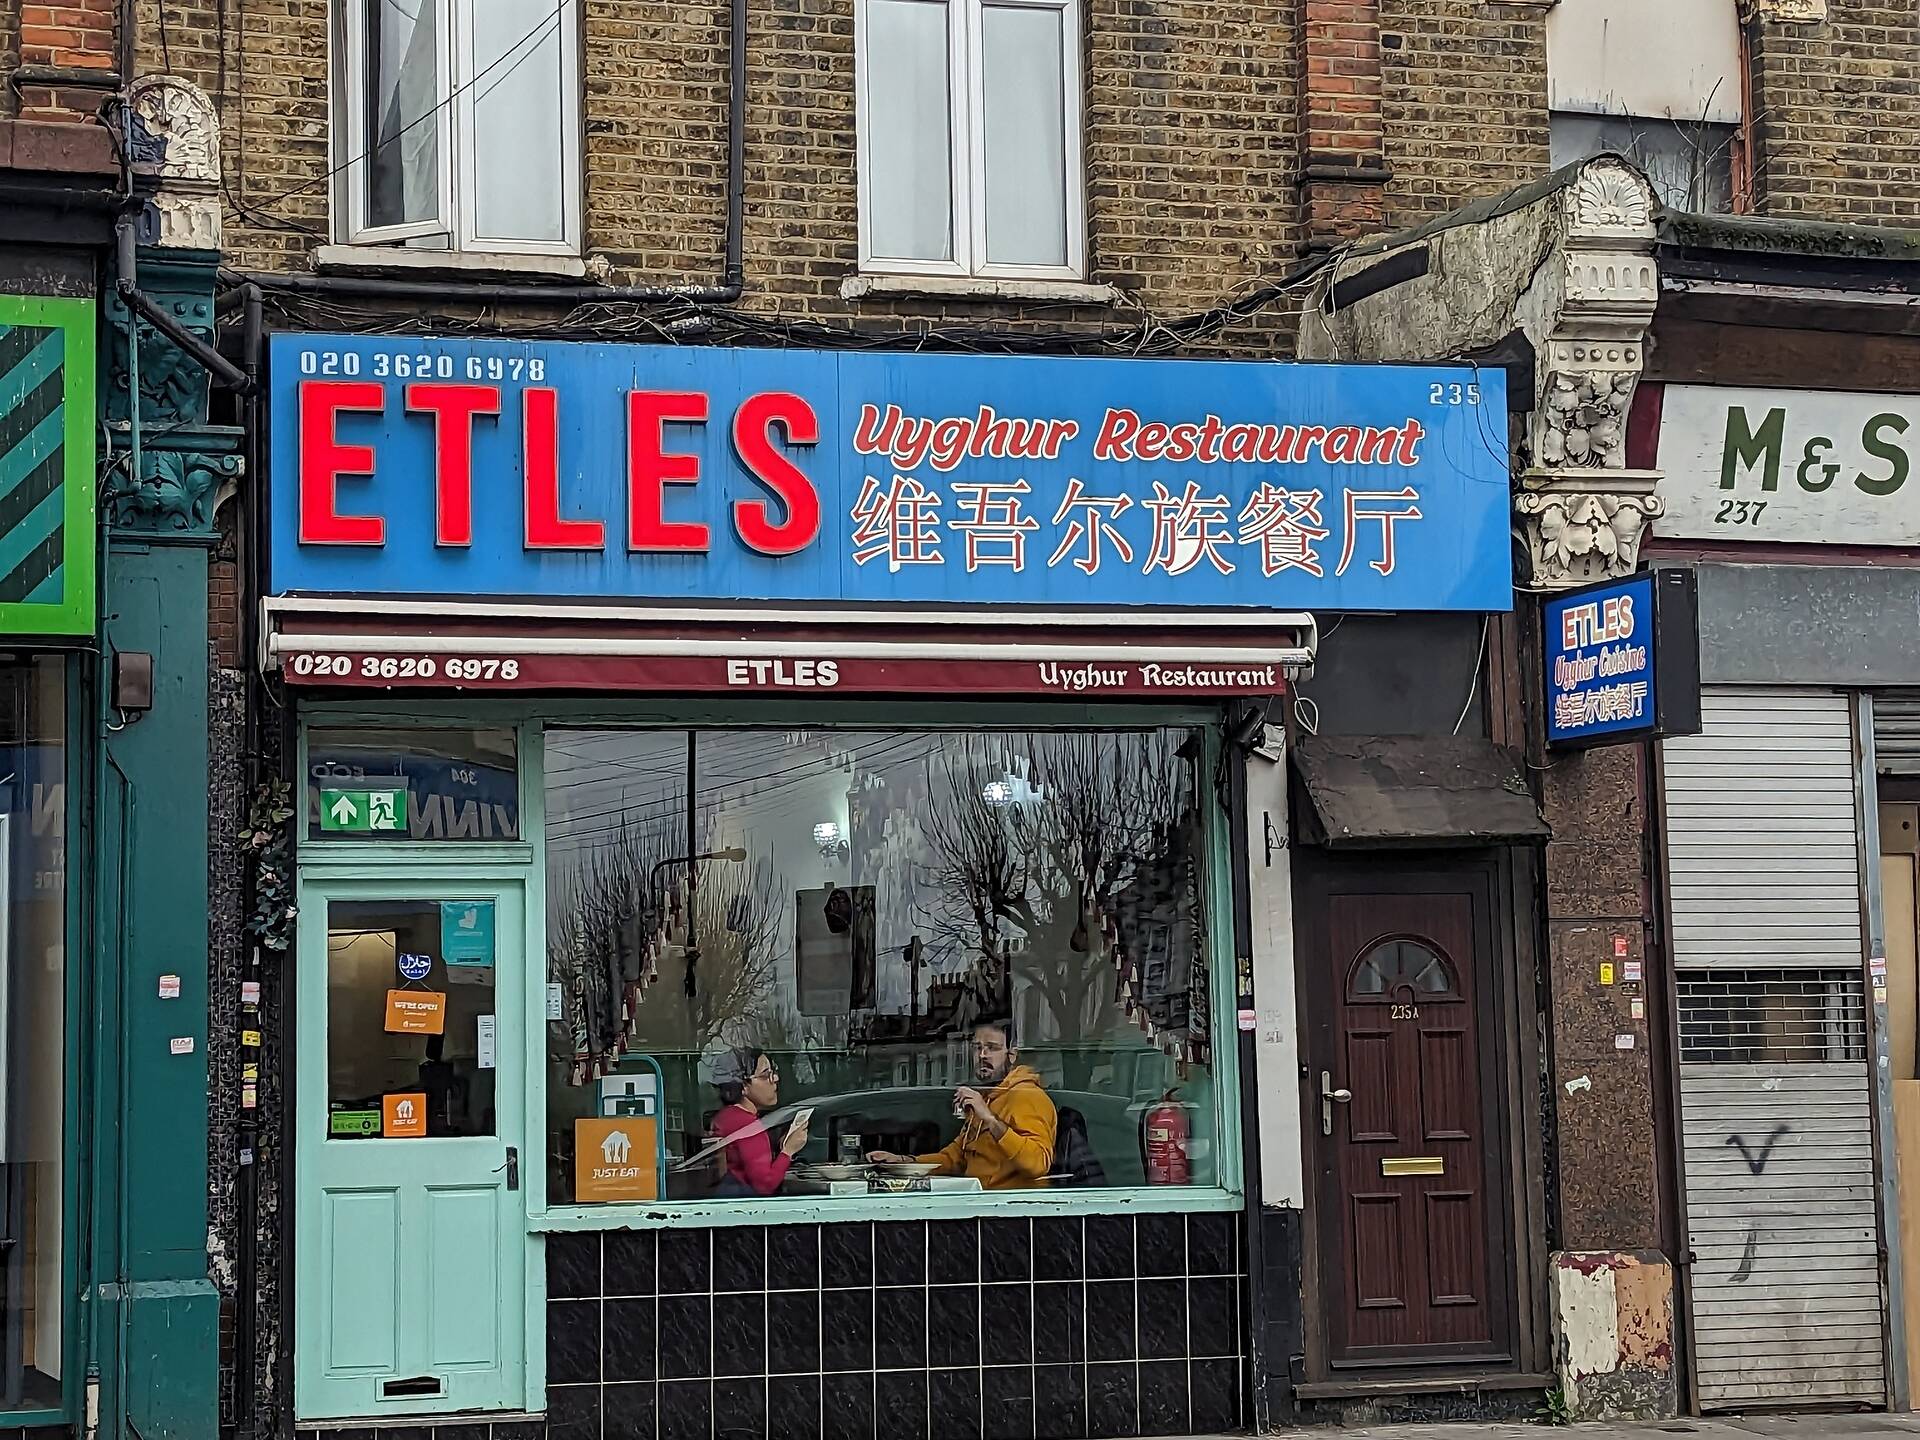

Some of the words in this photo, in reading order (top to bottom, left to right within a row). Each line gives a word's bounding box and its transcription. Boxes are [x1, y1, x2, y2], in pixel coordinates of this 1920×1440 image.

[301, 351, 360, 376] 020
[373, 353, 455, 379] 3620
[466, 357, 546, 381] 6978
[1429, 382, 1482, 405] 235
[853, 403, 1079, 470] Uyghur
[1094, 407, 1426, 467] Restaurant
[1718, 405, 1787, 493] M
[1796, 436, 1841, 494] &
[1853, 412, 1912, 496] S
[299, 381, 820, 556] ETLES
[850, 474, 1424, 578] 维吾尔族餐厅
[1713, 499, 1768, 526] 237
[1562, 595, 1634, 651] ETLES
[293, 655, 352, 676] 020
[361, 657, 436, 678] 3620
[444, 658, 520, 680] 6978
[726, 660, 839, 686] ETLES
[1599, 643, 1646, 677] Cuisine
[1038, 661, 1128, 691] Uyghur
[1138, 662, 1276, 688] Restaurant
[592, 1168, 618, 1179] JUST
[619, 1168, 639, 1178] EAT
